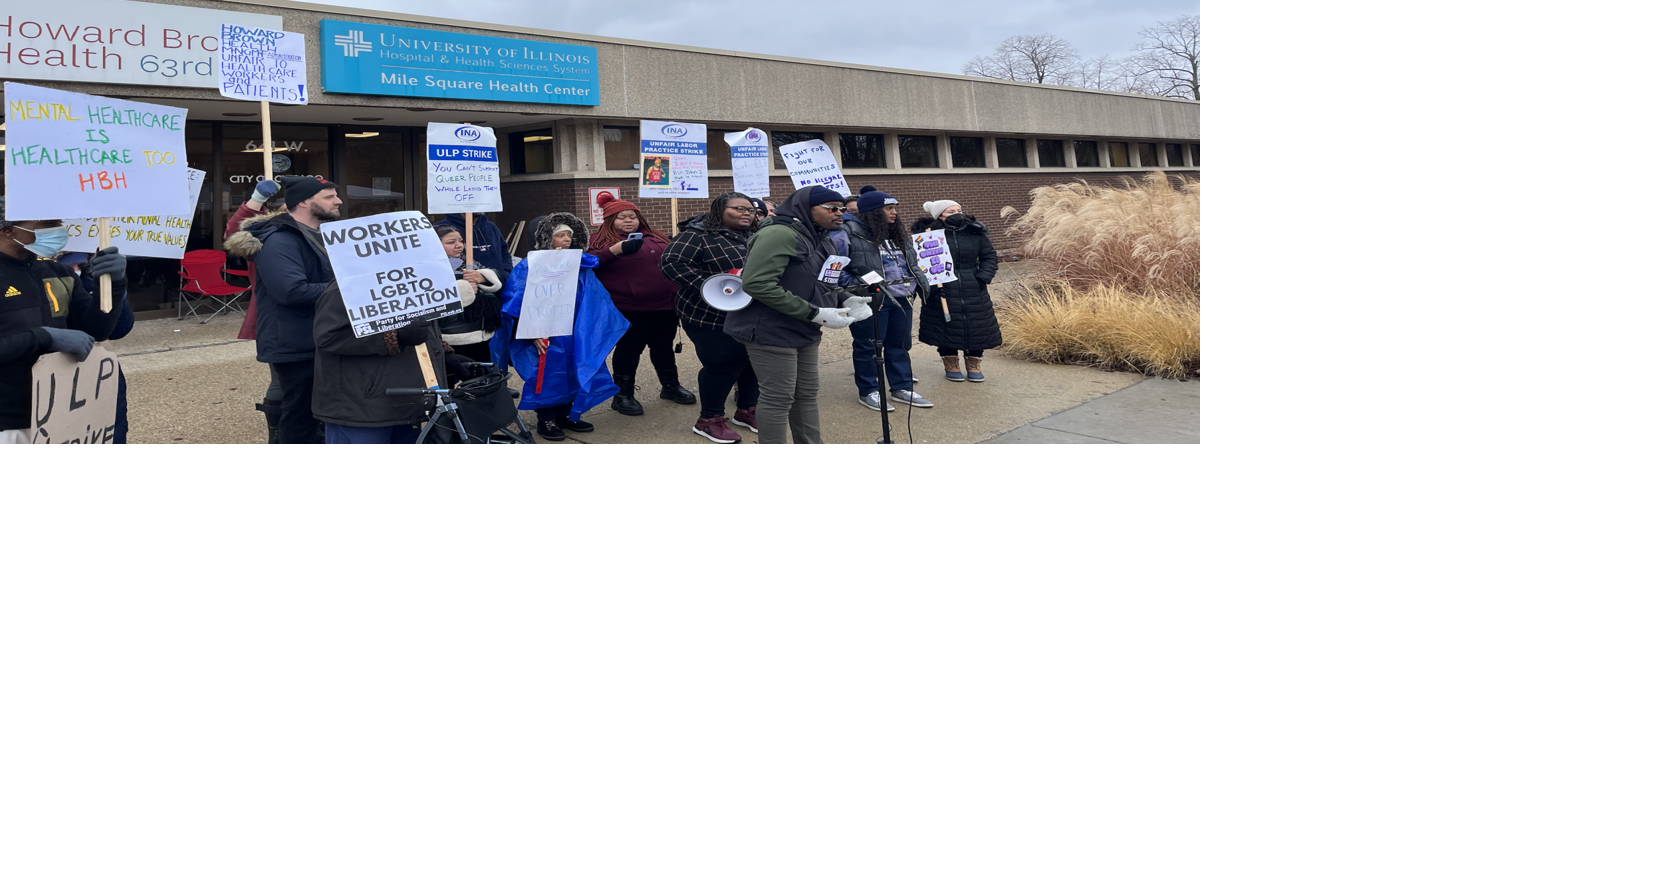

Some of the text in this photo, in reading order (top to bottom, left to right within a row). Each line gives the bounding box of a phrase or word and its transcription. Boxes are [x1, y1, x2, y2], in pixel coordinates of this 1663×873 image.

[221, 31, 275, 47] BROWN
[222, 24, 285, 39] HOWARD
[163, 28, 218, 52] Bro
[222, 39, 277, 53] HEALTH
[380, 33, 491, 56] UNIVERSITY
[523, 47, 590, 64] ILLINOIS
[140, 55, 212, 77] 63rd
[222, 54, 287, 68] UNFAIR TO
[222, 61, 297, 77] HEALTH CARE
[380, 49, 590, 74] Hospital & Health Sciences System
[222, 70, 285, 83] WORKERS
[229, 77, 250, 85] and
[381, 72, 590, 96] Mile Square Health Center
[223, 82, 305, 102] PATIENTS!
[10, 99, 182, 131] MENTAL HEALTHCARE
[86, 129, 110, 144] IS
[460, 129, 478, 137] INA
[284, 141, 308, 152] W.
[436, 149, 493, 158] ULP STRIKE
[11, 144, 176, 167] HEALTHCARE TOO
[435, 173, 493, 183] QUEER PEOPLE
[789, 164, 836, 176] COMMUNITIES
[78, 170, 128, 192] HBH
[229, 175, 254, 183] CITY
[454, 193, 474, 201] OFF
[165, 215, 191, 229] HEALTH
[125, 229, 145, 242] YOUR
[146, 229, 163, 243] TRUE
[163, 232, 187, 249] VALUES
[323, 216, 432, 246] WORKERS
[354, 234, 421, 258] UNITE
[375, 266, 417, 285] FOR
[370, 278, 435, 302] LGBTQ
[534, 282, 566, 298] OVER
[348, 286, 458, 321] LIBERATION
[527, 303, 574, 320] PROFITS
[375, 317, 394, 326] Party
[406, 308, 436, 319] Socialism
[436, 304, 447, 312] and
[378, 319, 412, 332] Liberation
[36, 357, 114, 429] ULP
